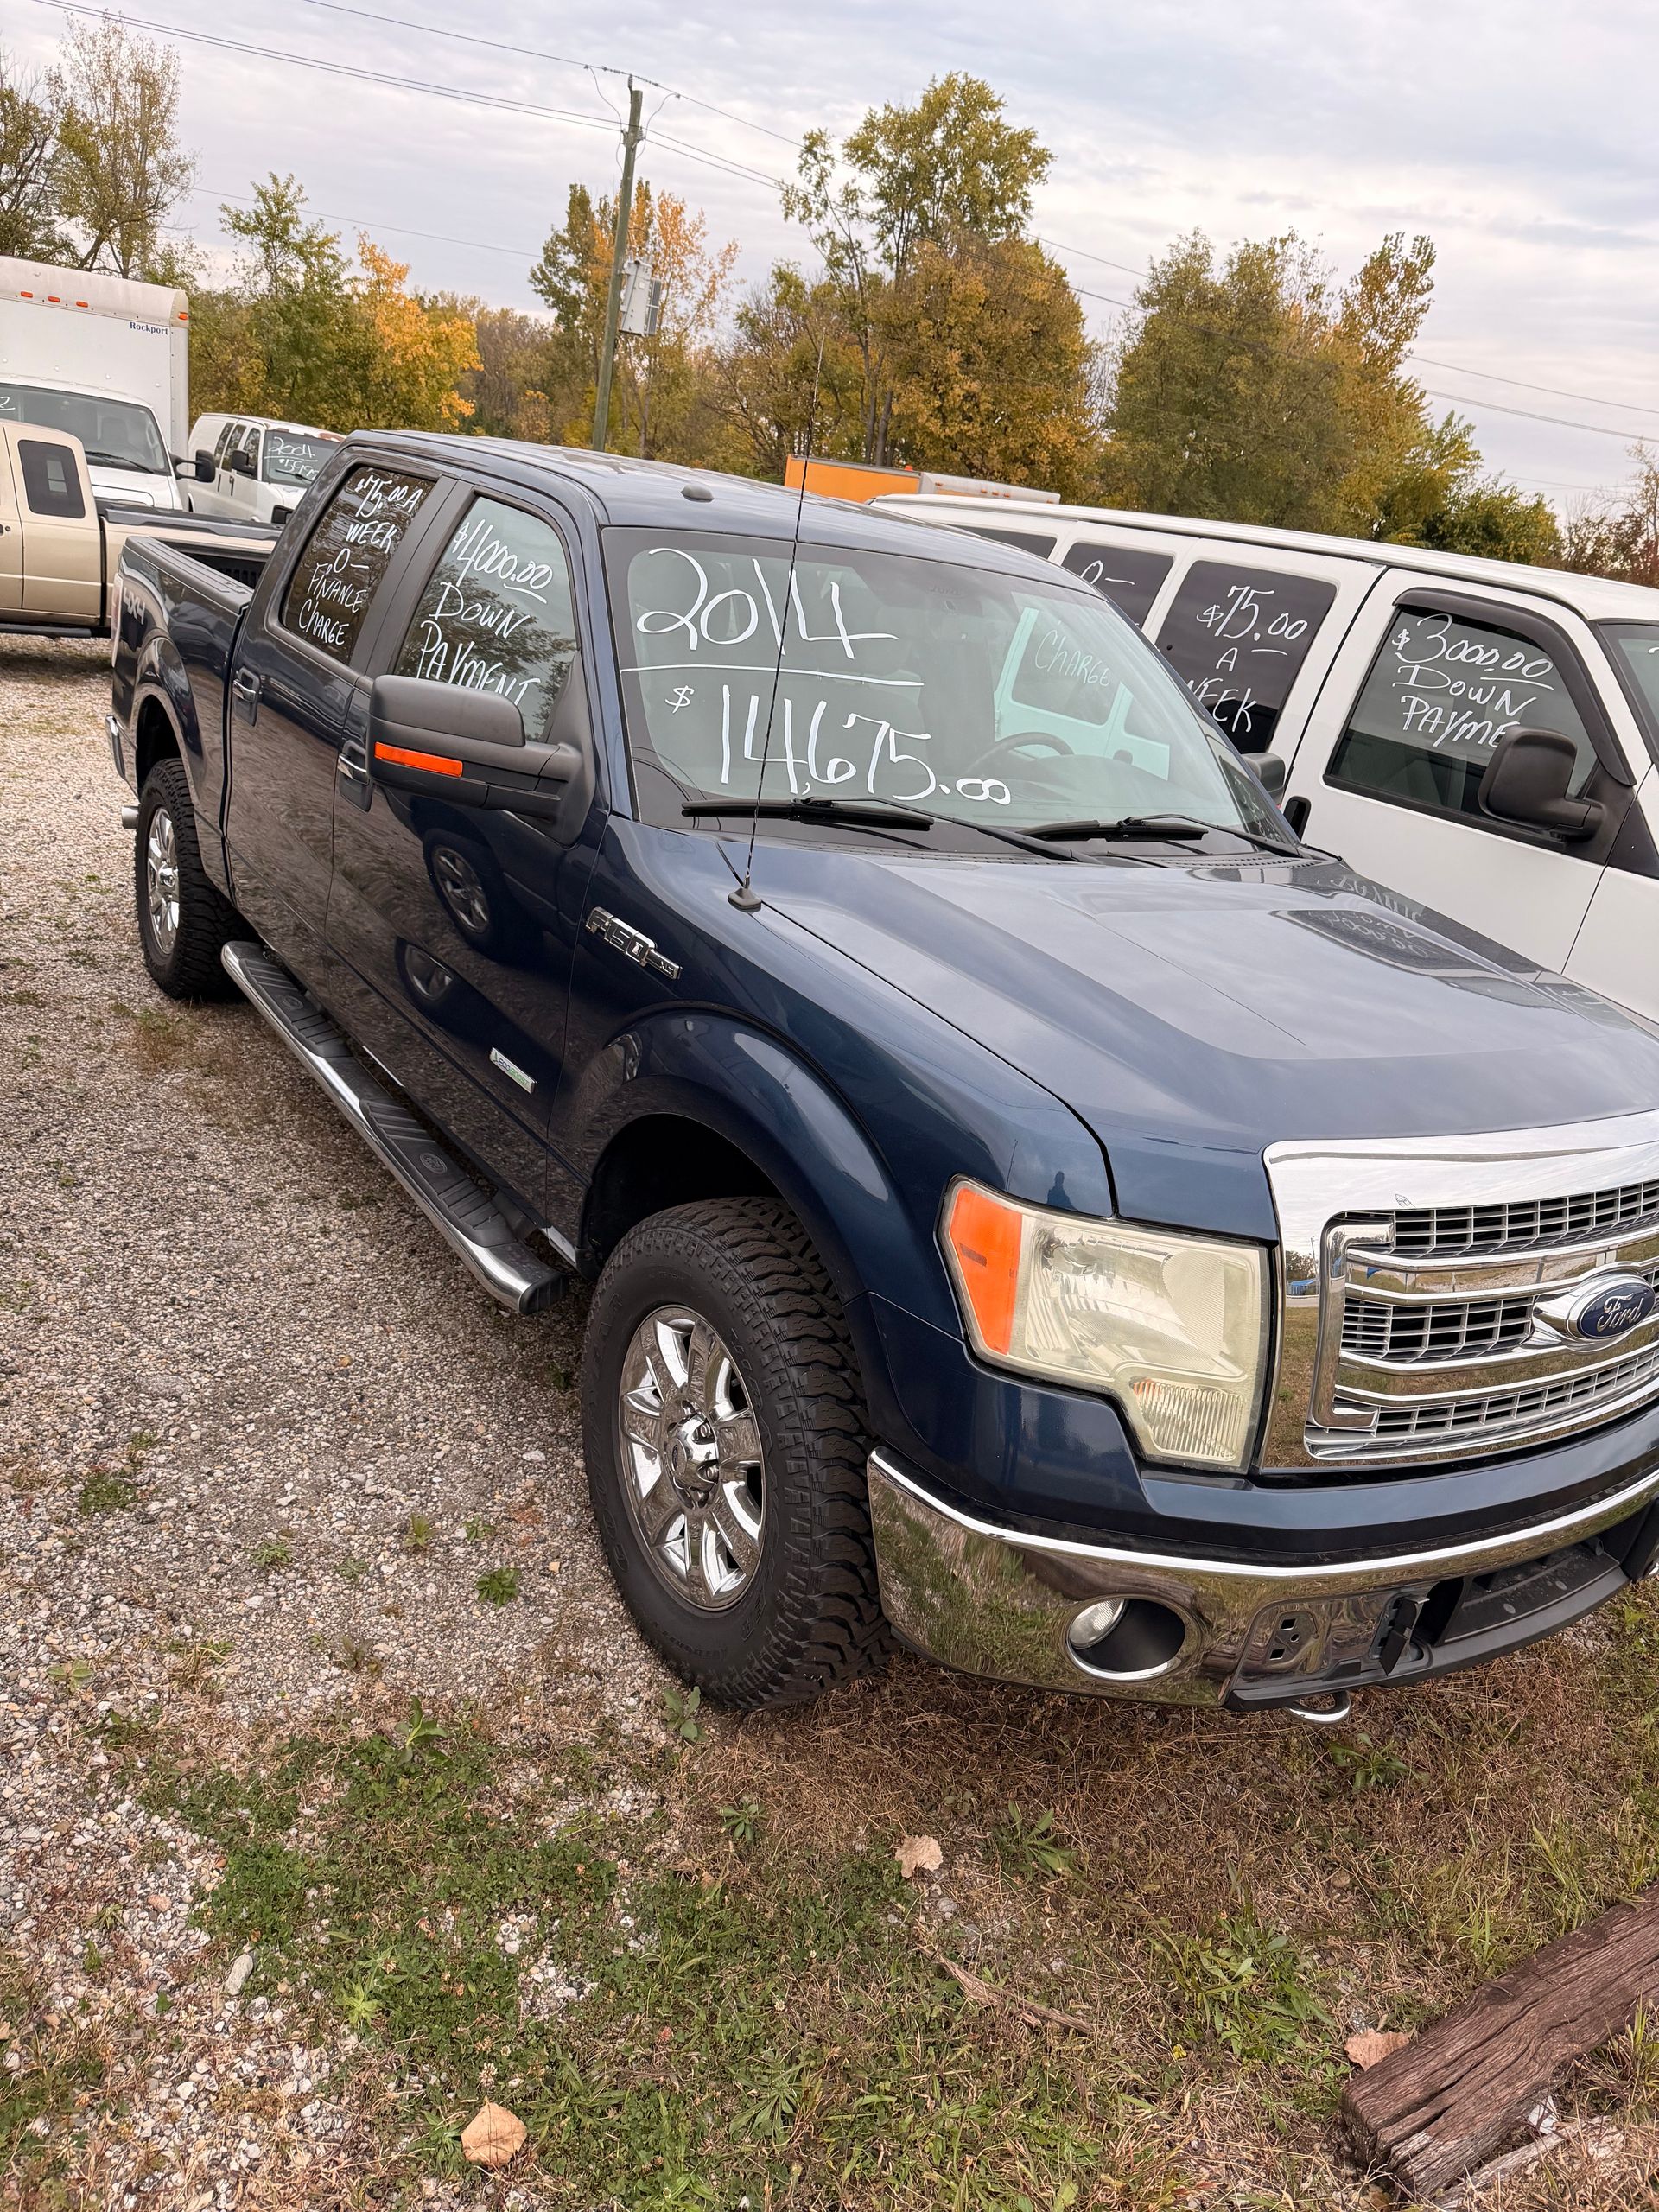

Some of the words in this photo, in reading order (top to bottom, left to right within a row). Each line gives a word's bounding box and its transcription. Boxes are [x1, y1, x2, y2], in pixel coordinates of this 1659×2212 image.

[130, 322, 168, 335] Rockport
[269, 436, 315, 458] 2004
[346, 520, 397, 554] WEEK
[453, 518, 553, 590] $4000.00
[307, 562, 368, 613] FINANCE
[637, 548, 899, 659] 2014
[1197, 585, 1308, 641] $75.00
[1215, 647, 1238, 672] A
[1392, 613, 1554, 678] $3000.00
[1401, 695, 1521, 748] PAYME
[1597, 1293, 1645, 1332] Ford
